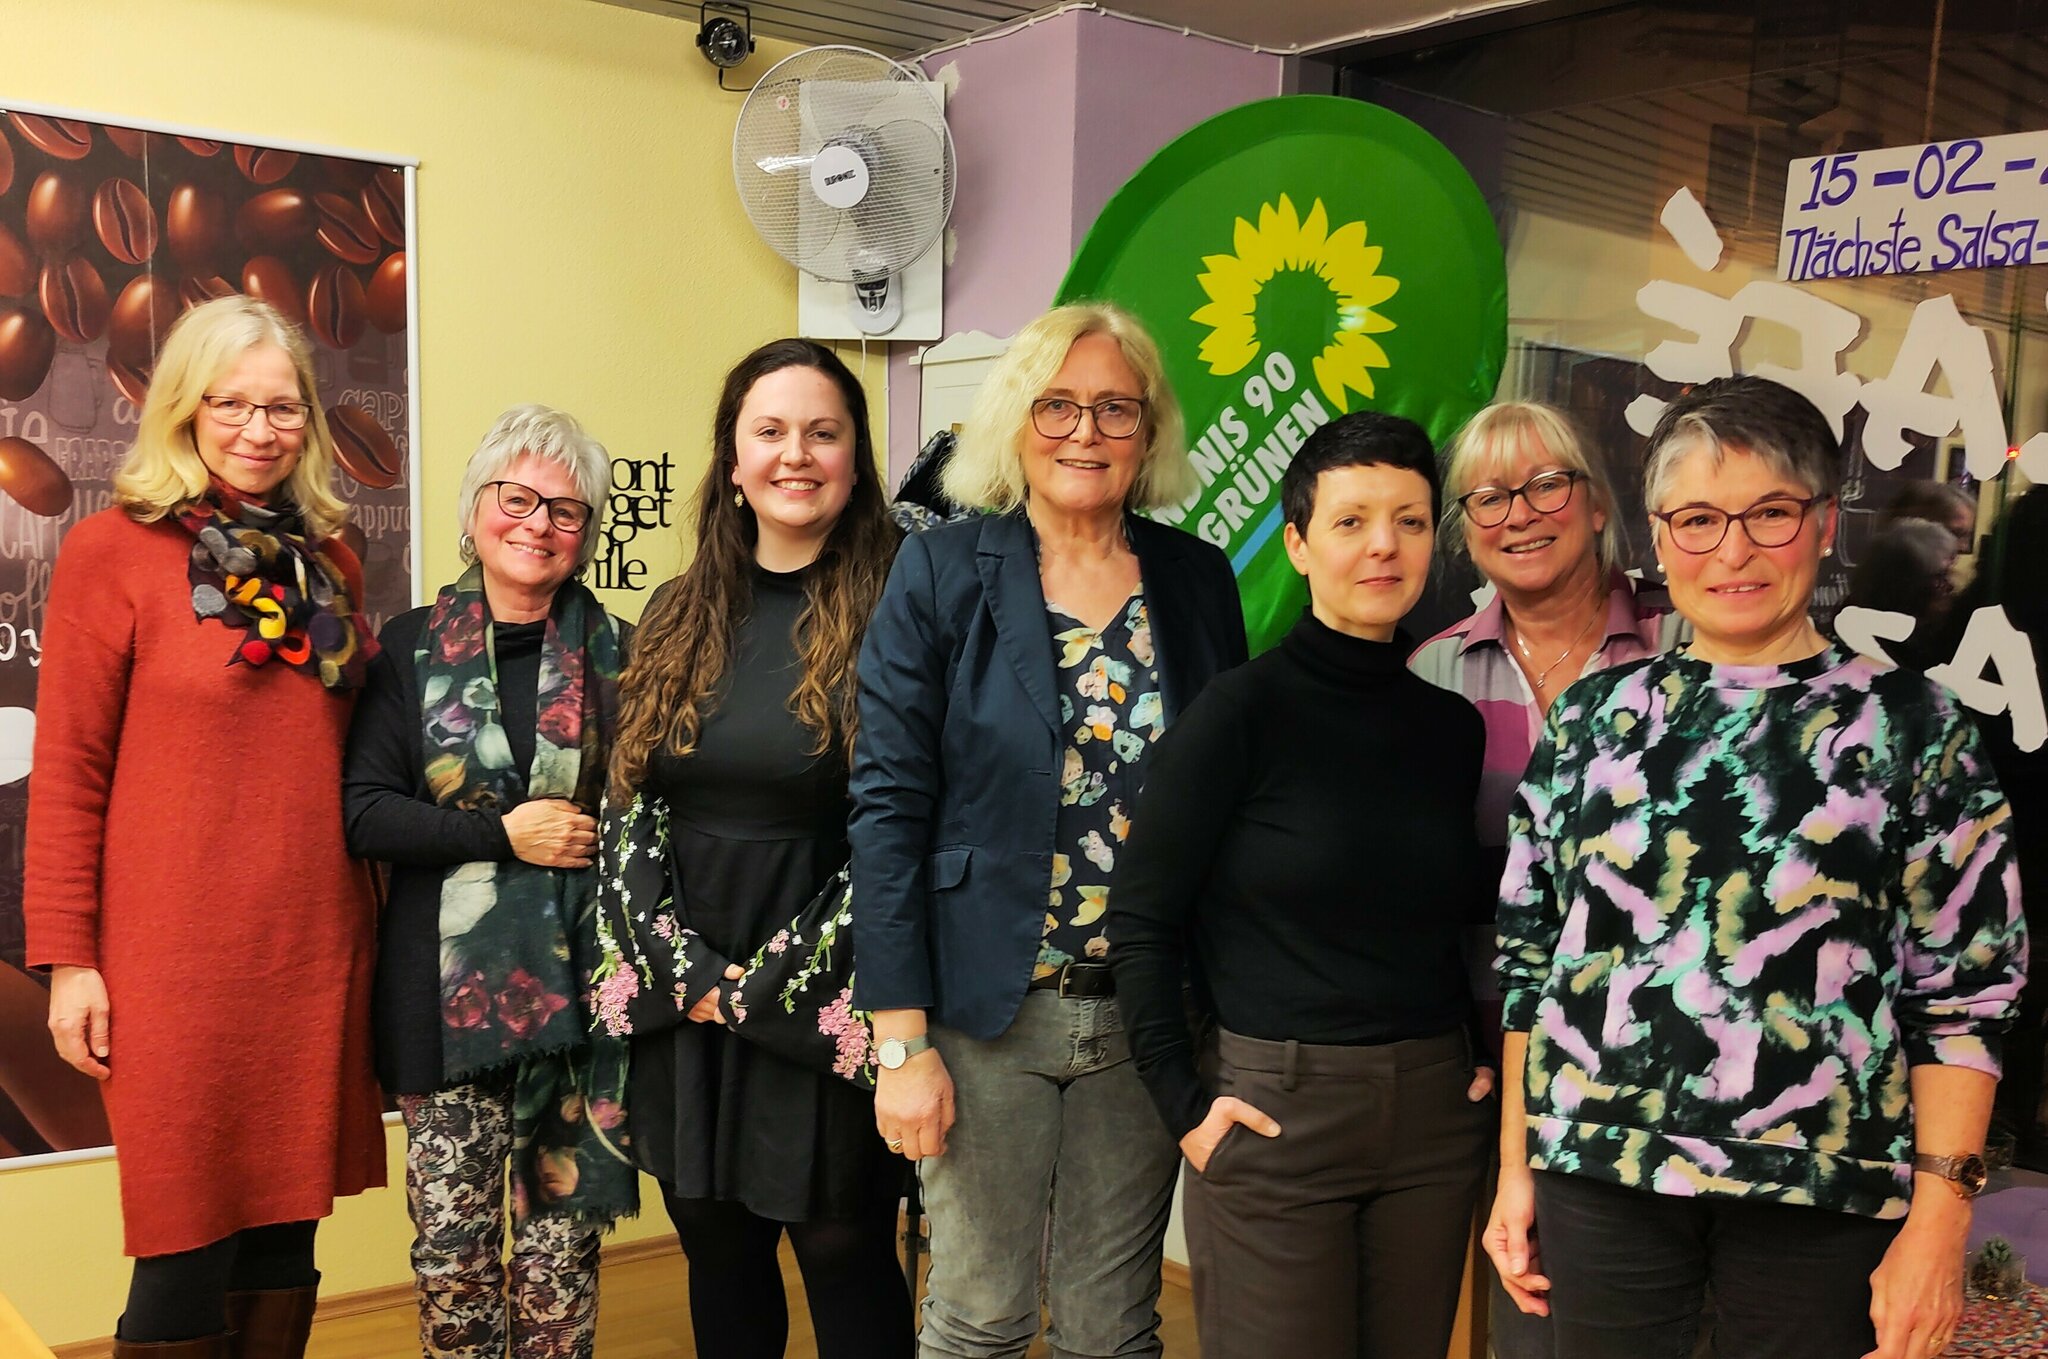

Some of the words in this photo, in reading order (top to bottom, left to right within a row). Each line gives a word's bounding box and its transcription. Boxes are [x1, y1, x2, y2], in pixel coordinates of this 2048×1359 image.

[1785, 207, 1922, 281] Nächste
[1243, 351, 1297, 418] 90
[610, 451, 676, 494] ont
[1196, 388, 1331, 550] GRÜNEN
[609, 487, 673, 544] get
